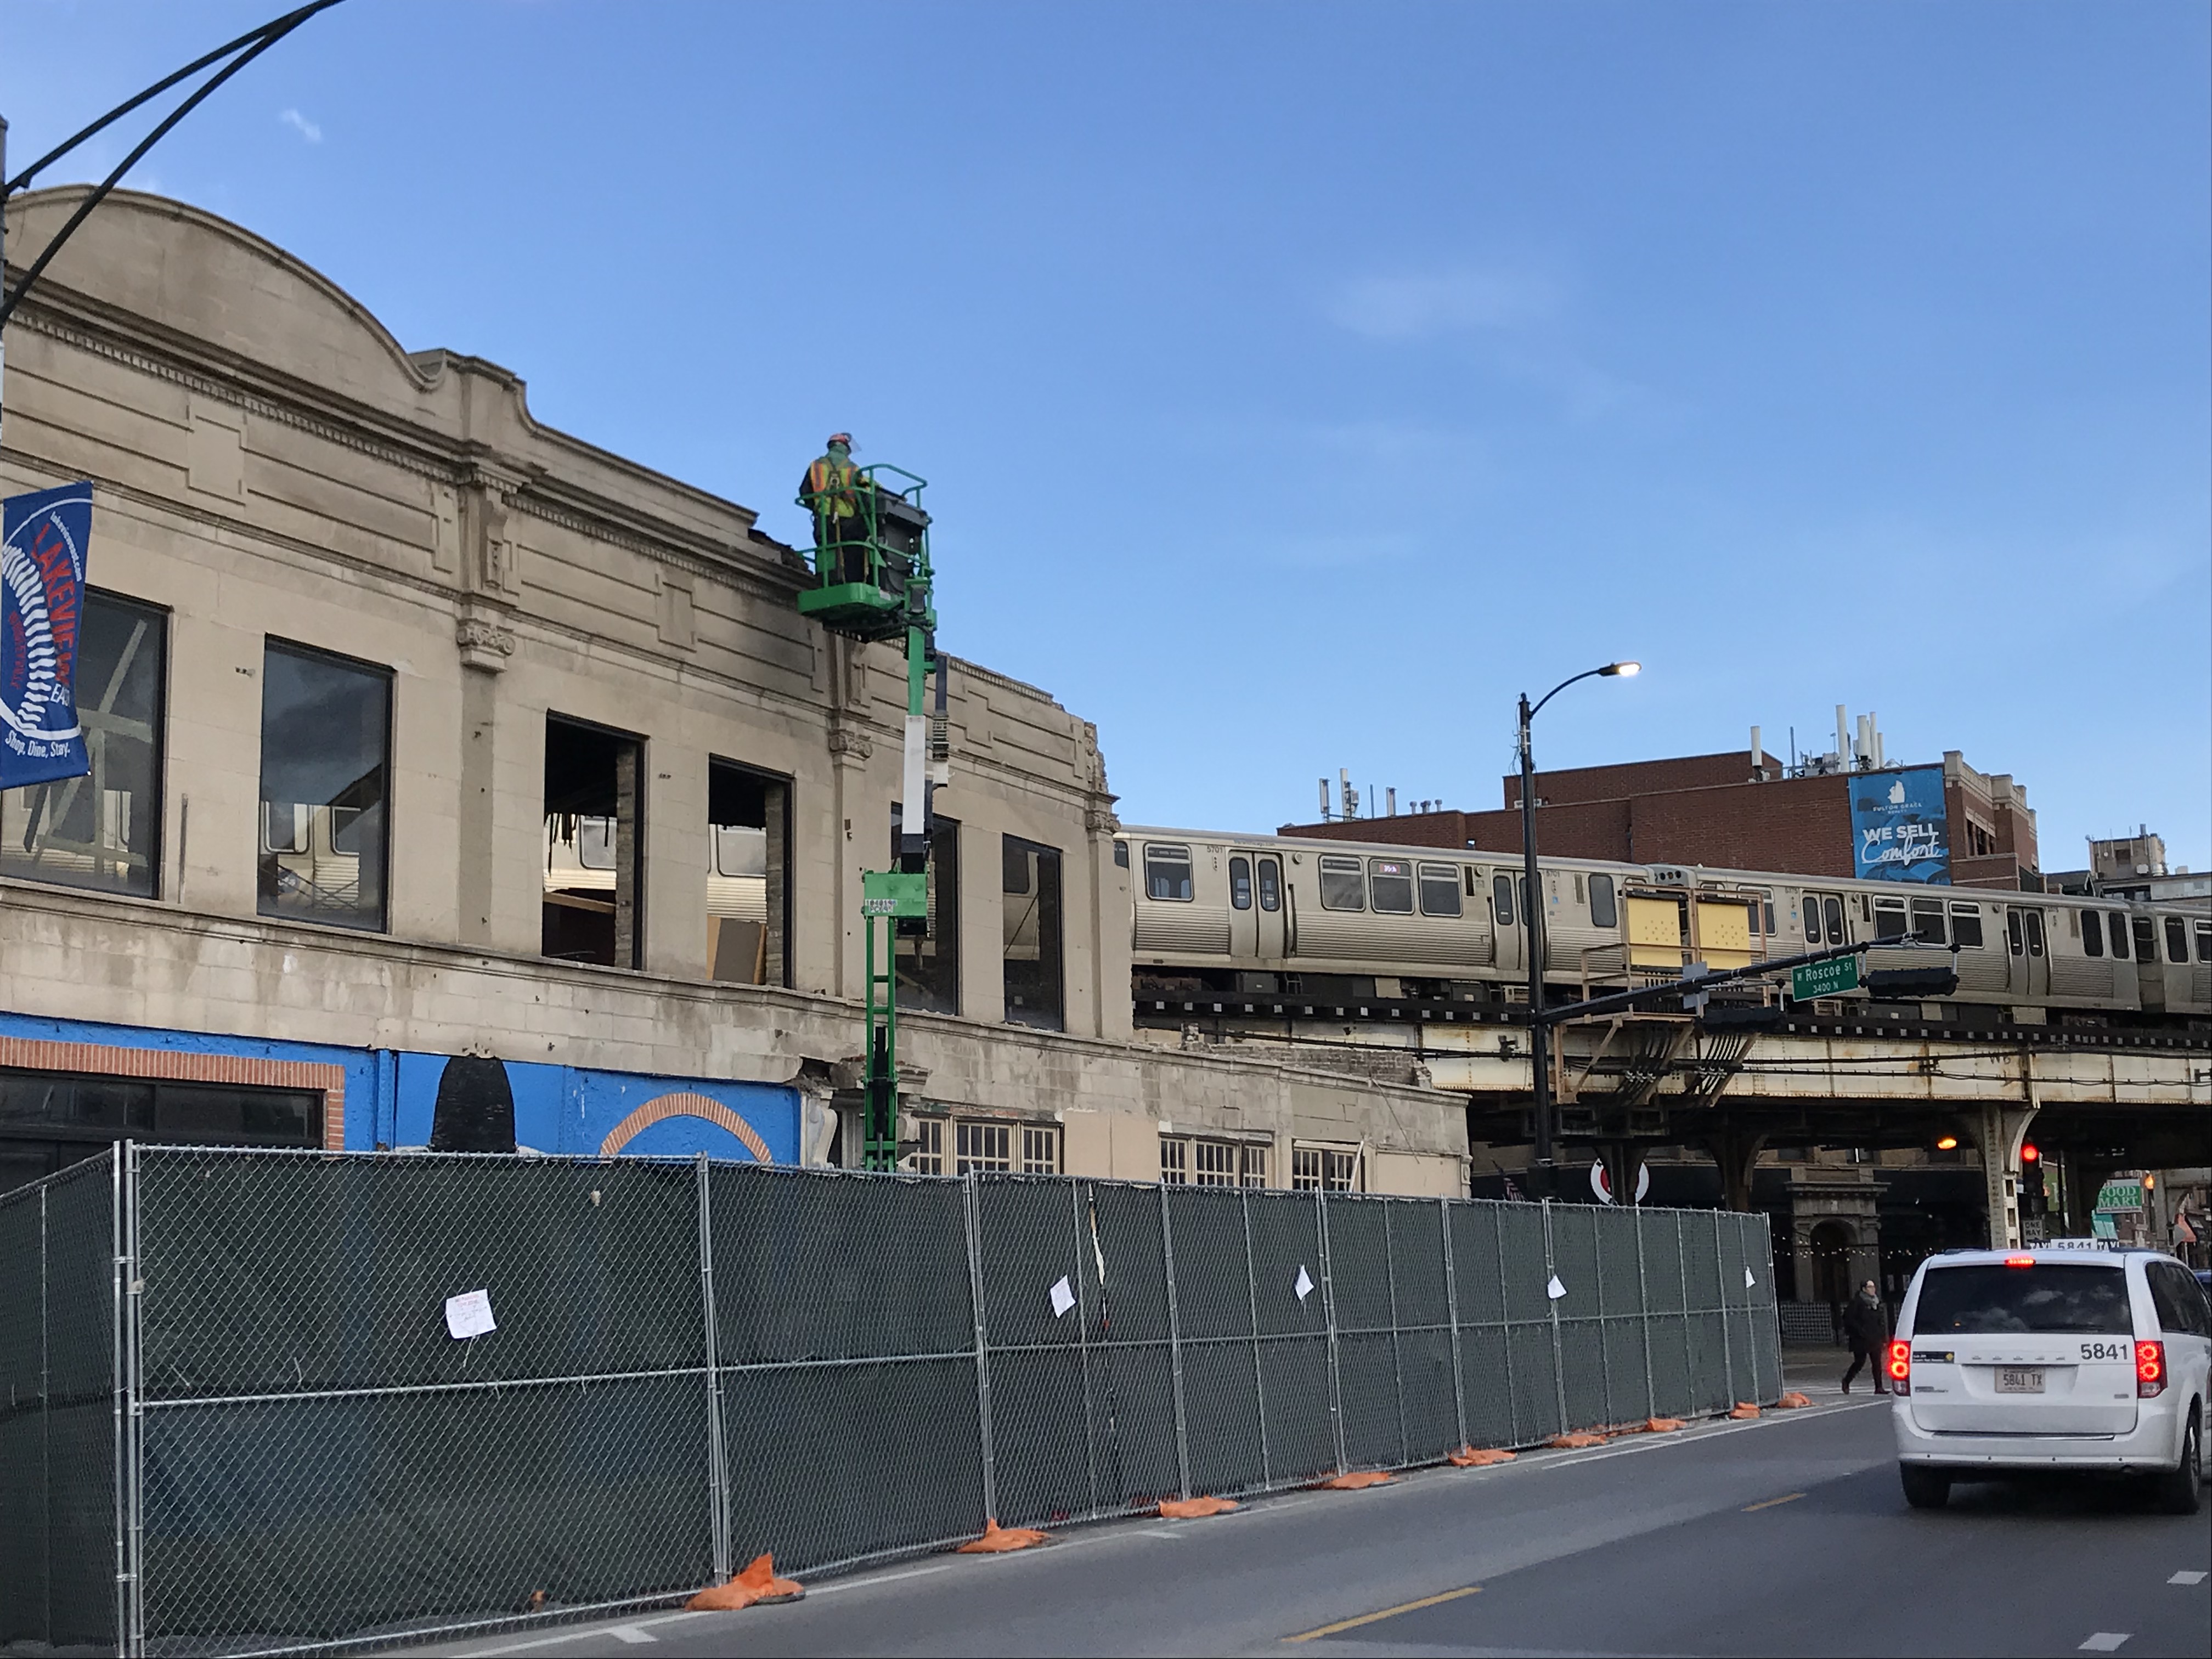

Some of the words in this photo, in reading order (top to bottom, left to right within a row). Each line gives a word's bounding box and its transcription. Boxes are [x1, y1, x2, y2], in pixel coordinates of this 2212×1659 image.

[31, 523, 76, 685] LAKEVIEW
[27, 740, 49, 758] Dine,
[50, 741, 70, 758] Stay.
[1862, 826, 1893, 842] WE
[1896, 823, 1939, 839] SELL
[1207, 845, 1223, 854] 5701
[1861, 834, 1943, 866] Comfort
[1797, 972, 1803, 981] W
[1805, 964, 1841, 981] Roscoe
[1844, 962, 1853, 972] St
[1813, 982, 1831, 994] 3400
[1833, 981, 1839, 990] N
[2099, 1186, 2136, 1198] FOOD
[2097, 1196, 2138, 1207] MART
[2097, 1241, 2120, 1250] TAXI
[2081, 1343, 2128, 1360] 5841
[2004, 1374, 2026, 1386] 5841
[2031, 1373, 2042, 1386] TX
